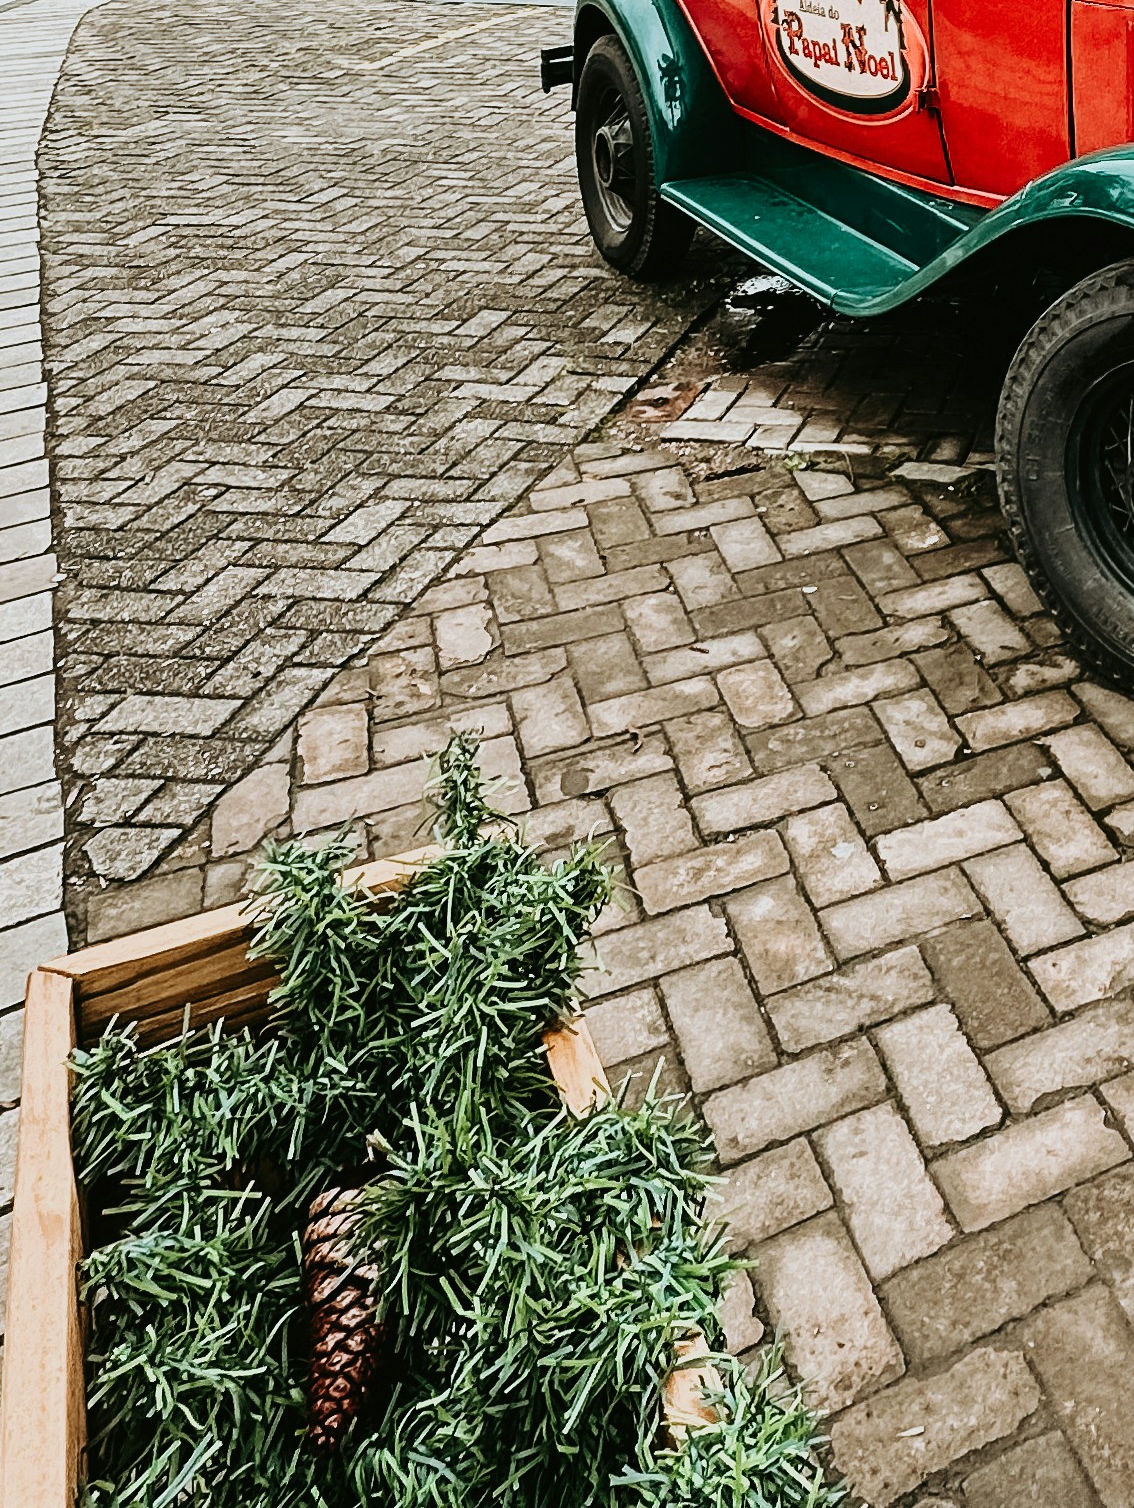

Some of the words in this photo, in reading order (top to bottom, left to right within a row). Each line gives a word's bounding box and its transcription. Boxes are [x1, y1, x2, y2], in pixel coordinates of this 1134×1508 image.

[828, 5, 840, 21] do
[781, 9, 840, 69] Papai
[840, 23, 899, 82] Noel
